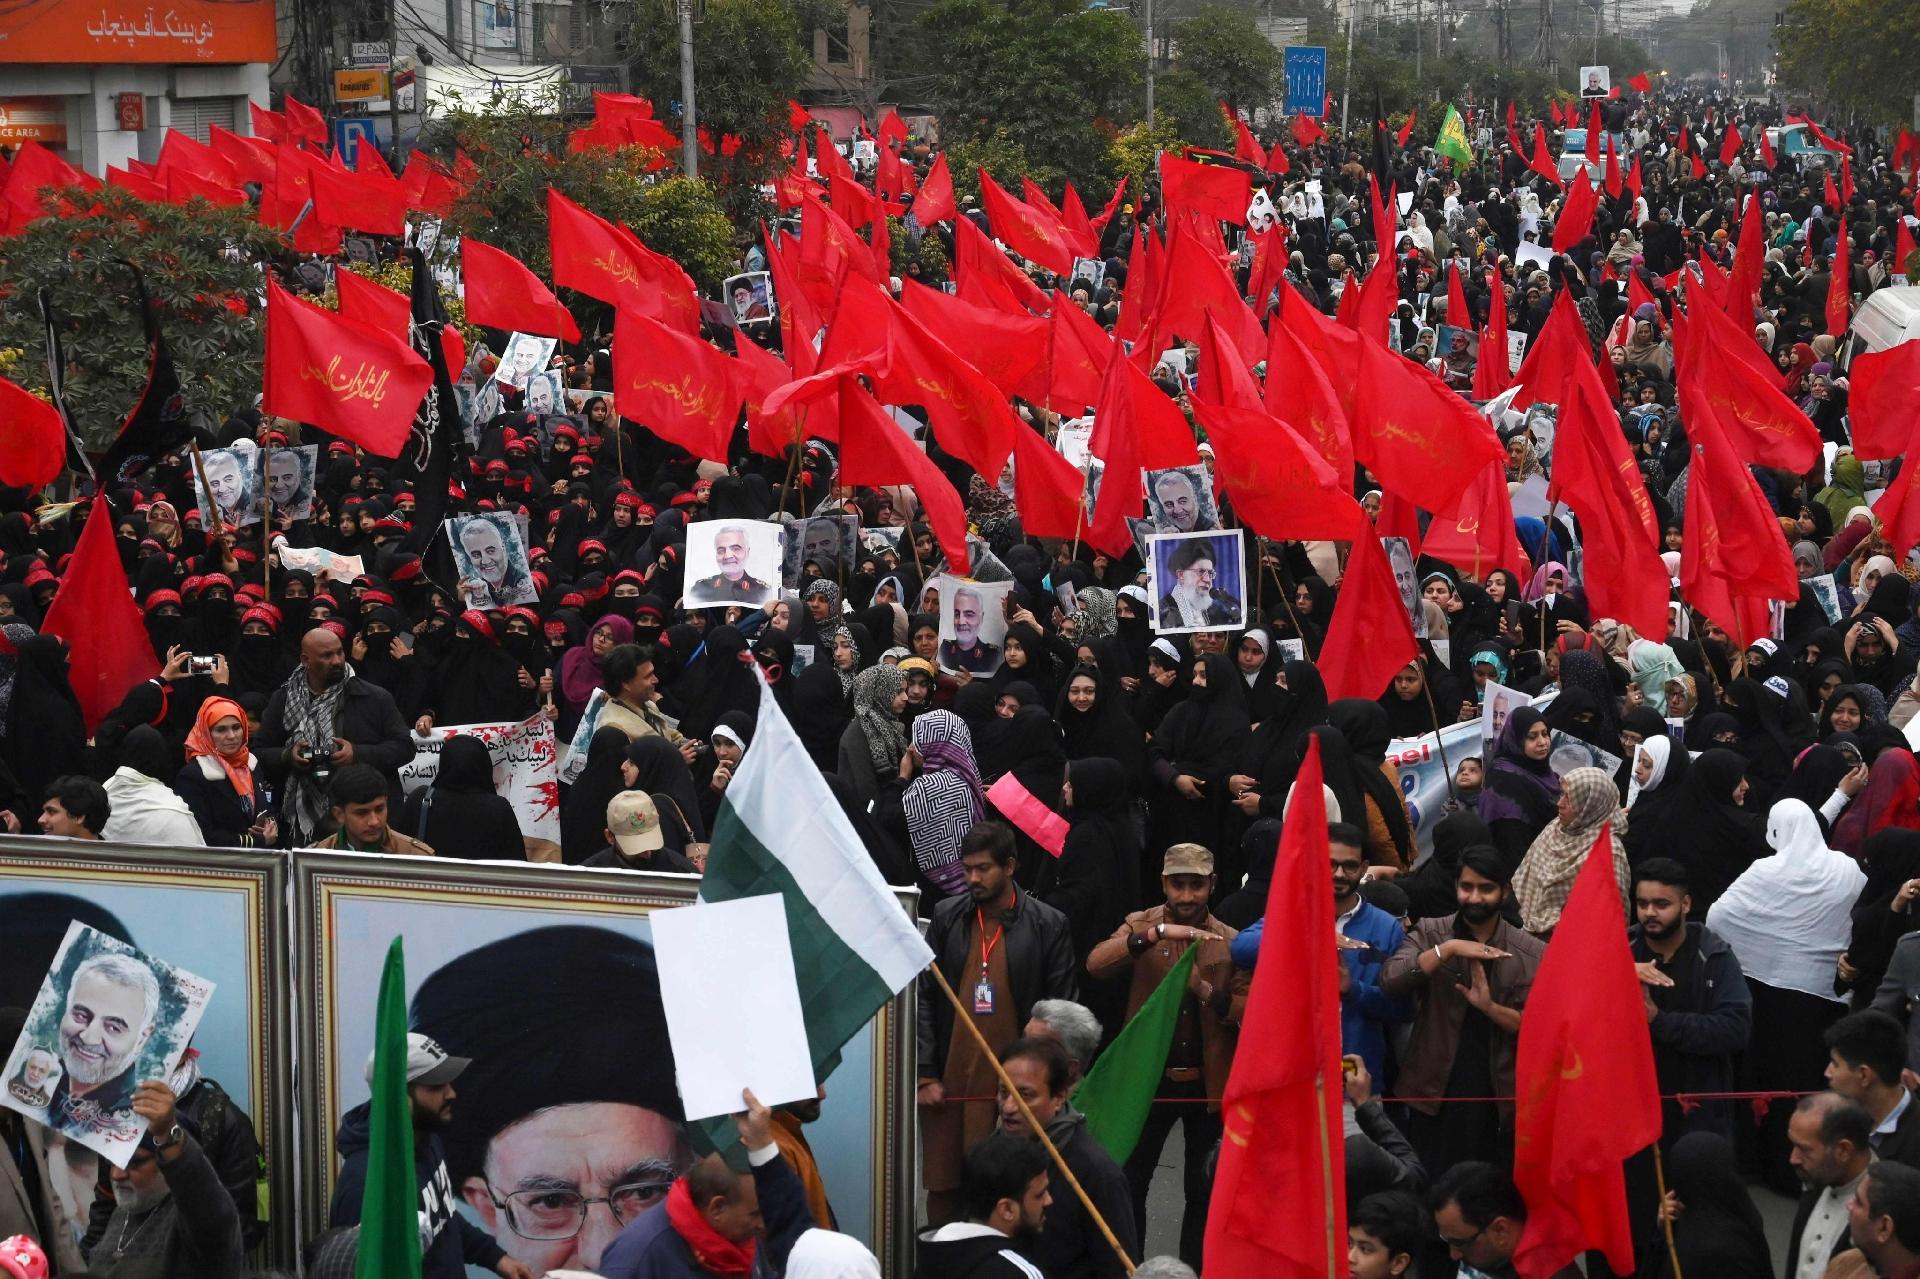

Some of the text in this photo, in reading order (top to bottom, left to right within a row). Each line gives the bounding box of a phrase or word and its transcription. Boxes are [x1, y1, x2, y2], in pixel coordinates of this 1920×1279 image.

[87, 9, 134, 47] پنجاب
[133, 6, 154, 37] آف
[154, 9, 195, 43] بینک
[354, 43, 387, 55] IRFAN
[0, 128, 40, 137] CE AREA
[344, 123, 365, 161] P
[1384, 744, 1431, 768] ael
